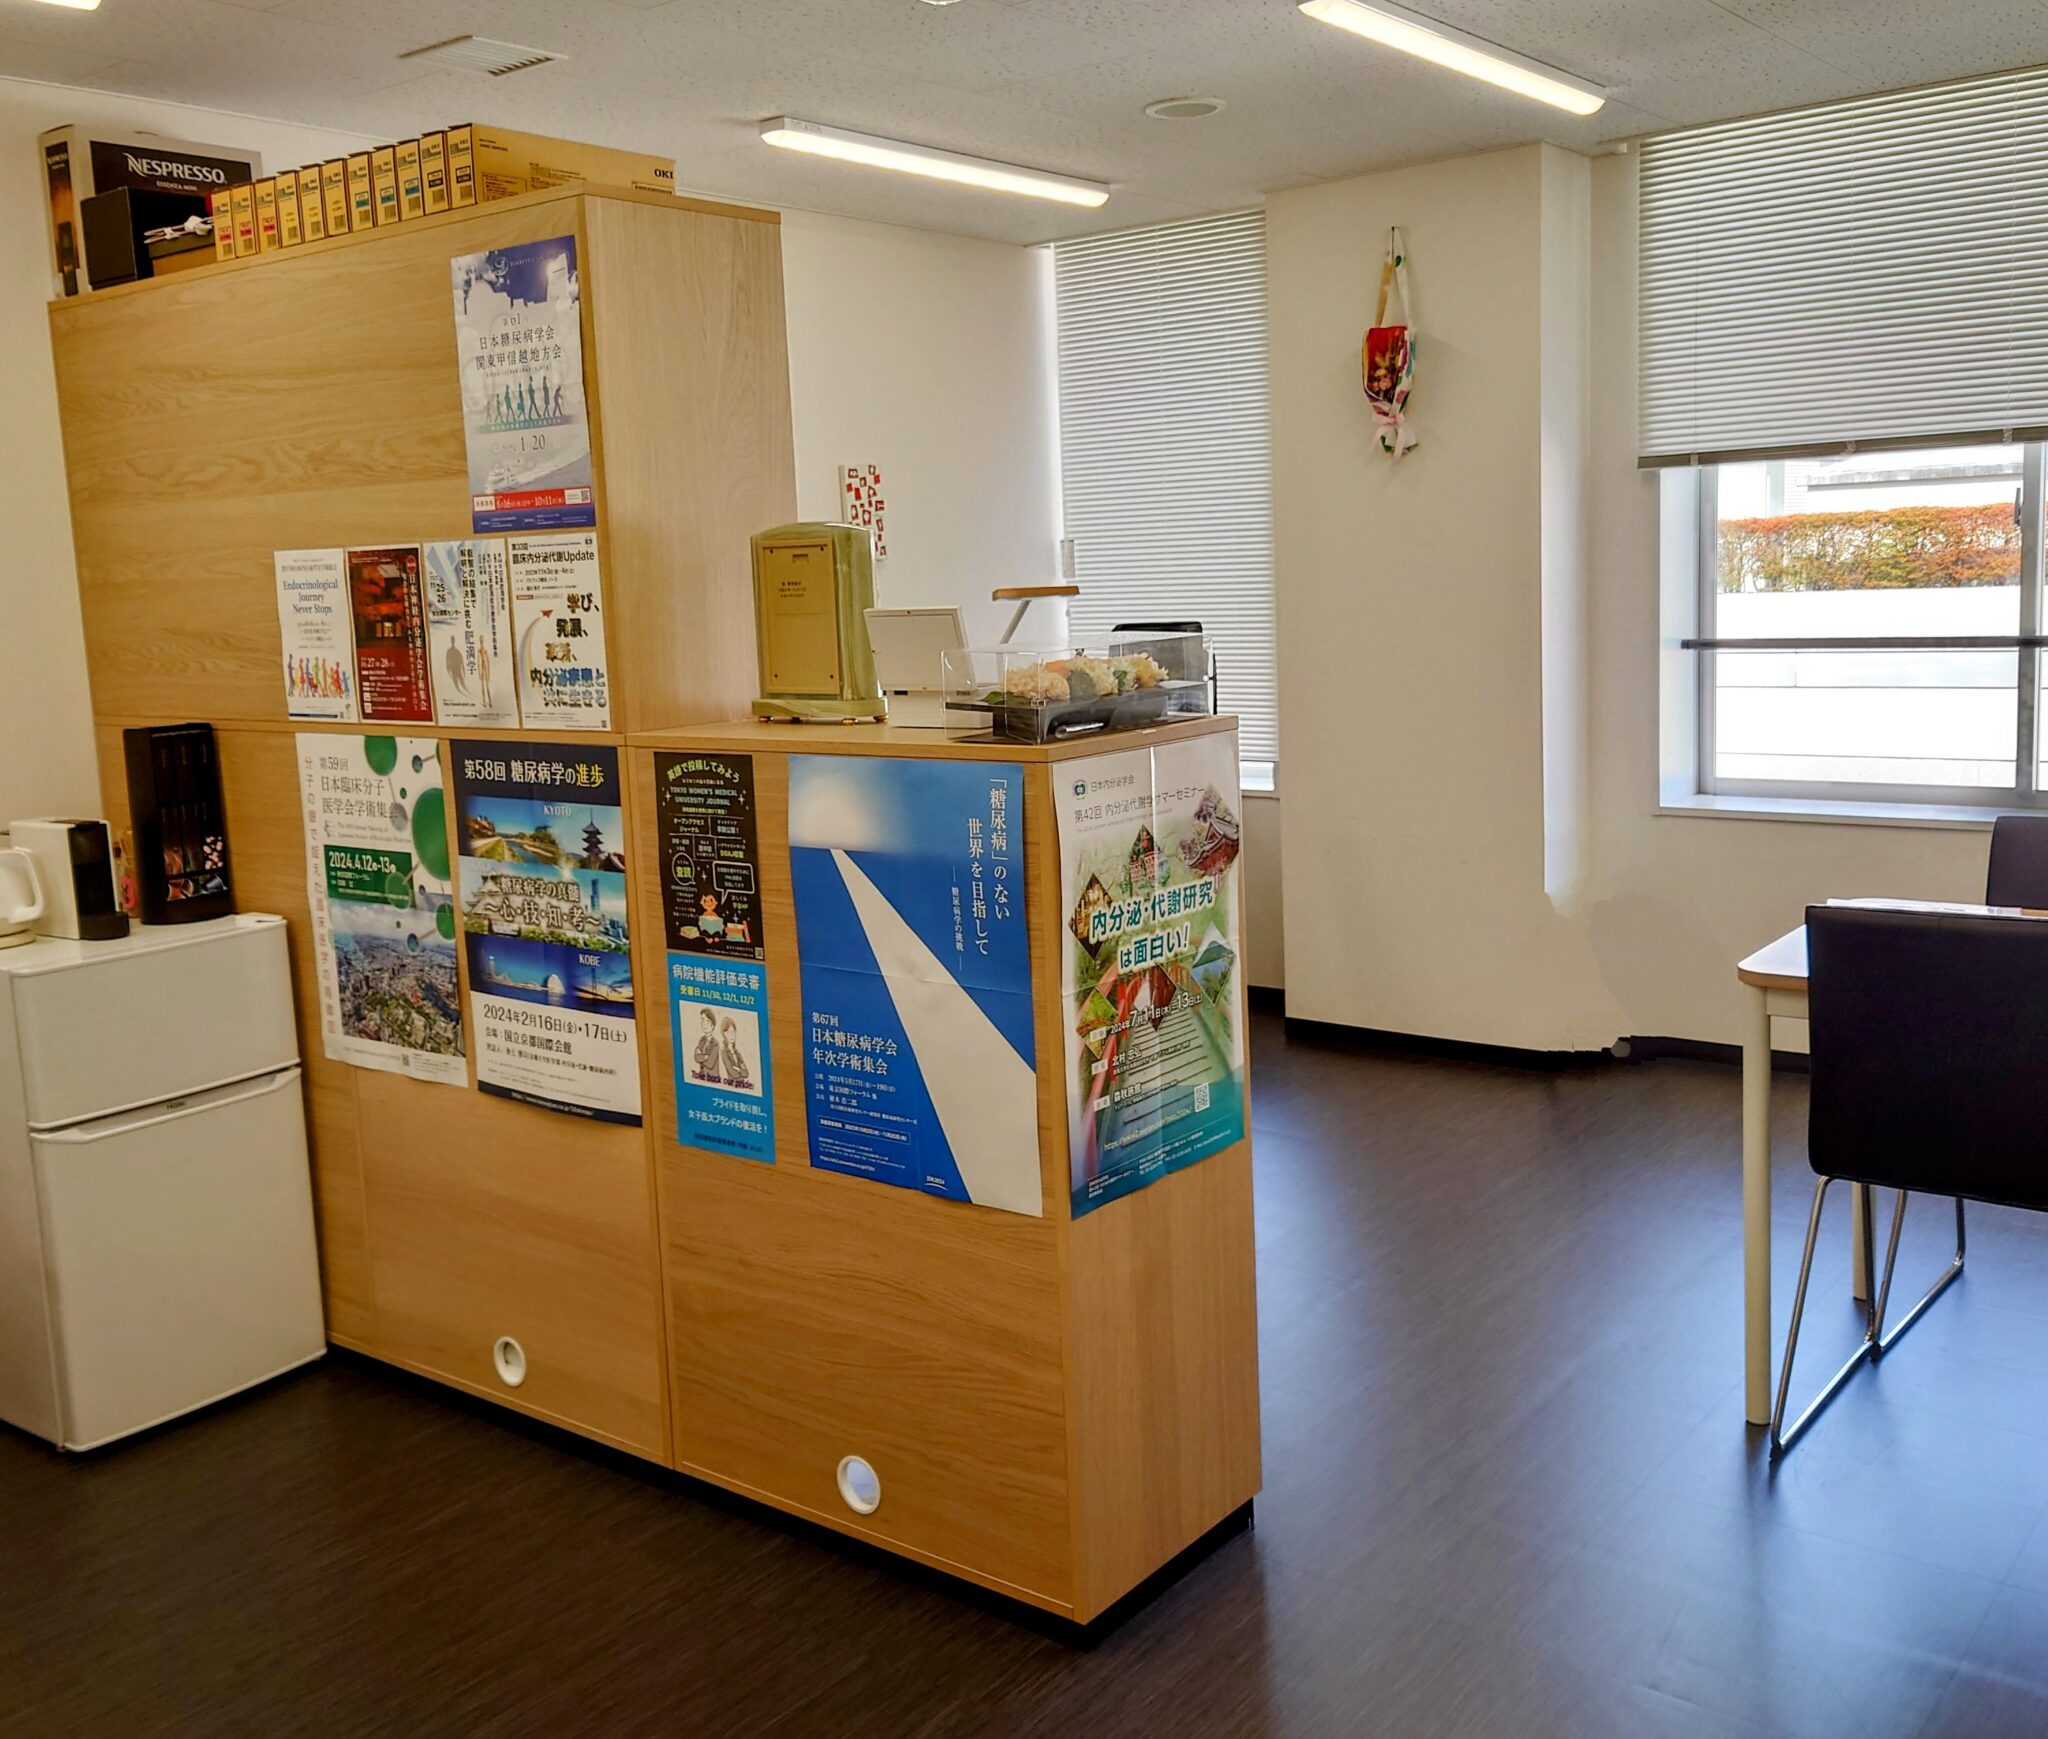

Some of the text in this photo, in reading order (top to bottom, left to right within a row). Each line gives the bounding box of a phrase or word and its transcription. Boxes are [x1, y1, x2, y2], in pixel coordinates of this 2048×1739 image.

[123, 152, 226, 184] NESPRESSO
[654, 168, 674, 180] OKI
[479, 325, 555, 350] 日本糖尿病学会
[475, 343, 562, 370] 関東甲信越地方会
[283, 579, 339, 591] Endocrinological
[298, 593, 325, 604] Journey
[567, 592, 600, 614] 学び、
[293, 604, 333, 616] Never Stops
[464, 759, 605, 788] 第58回 糖尿病学の進歩
[1091, 774, 1135, 793] 日本内分泌学会
[321, 776, 384, 796] 日本臨床分子
[714, 788, 738, 797] MEDICAL
[544, 805, 571, 817] KYOTO
[675, 796, 731, 806] UNIVERSITY JOURNAL
[1074, 805, 1103, 824] 第42回
[989, 779, 1010, 920] 「糖尿病」のない
[501, 876, 580, 902] 糖尿病学の真髄
[967, 818, 989, 955] 世界を目指して
[1091, 880, 1214, 939] 内分泌・代謝研究
[1119, 925, 1189, 968] は面白い!
[579, 953, 601, 967] KOBE
[672, 964, 761, 990] 病院機能評価受審
[811, 1011, 839, 1028] 第67回
[811, 1028, 898, 1056] 日本糖尿病学会
[811, 1048, 888, 1076] 年次学術集会
